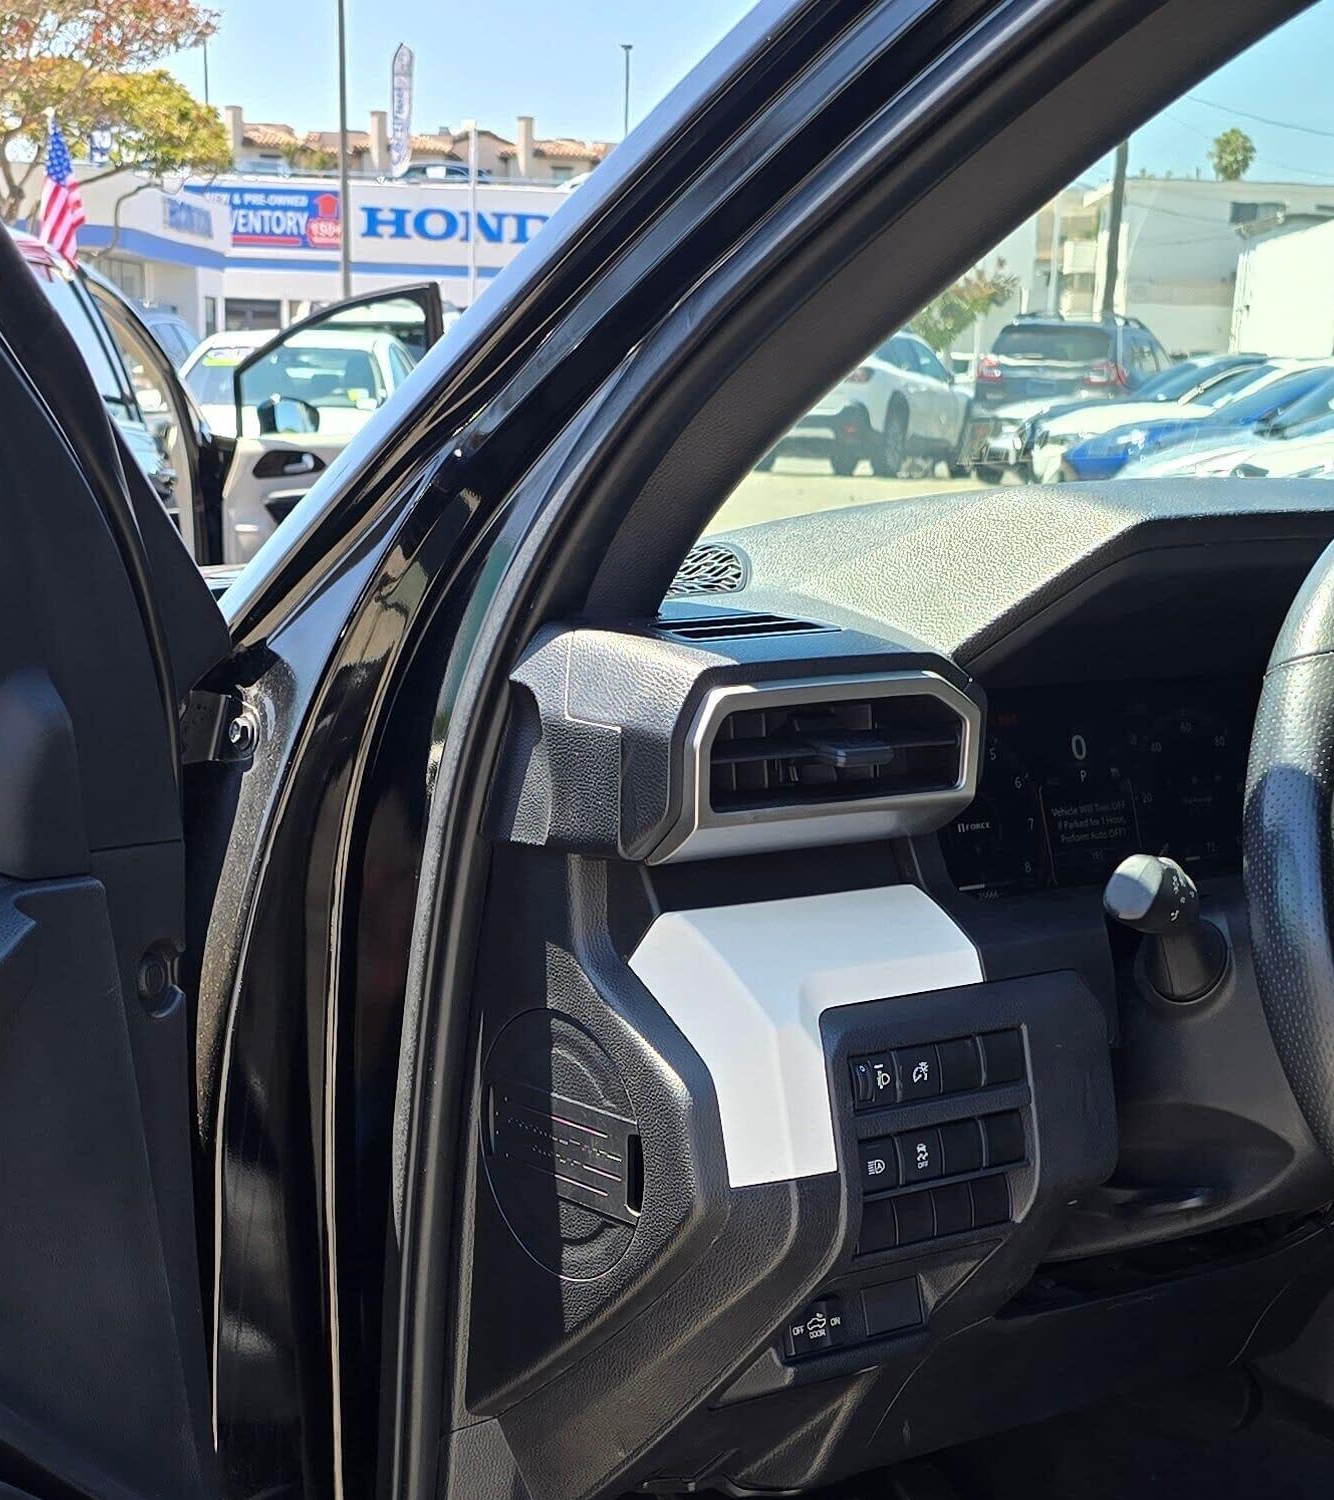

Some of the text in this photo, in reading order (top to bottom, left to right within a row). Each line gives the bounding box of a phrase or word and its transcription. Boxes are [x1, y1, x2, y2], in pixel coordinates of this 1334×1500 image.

[244, 193, 309, 208] PRE-OWNED
[917, 1159, 929, 1170] OFF
[792, 1315, 841, 1336] OFF ON
[809, 1328, 826, 1338] DOOR
